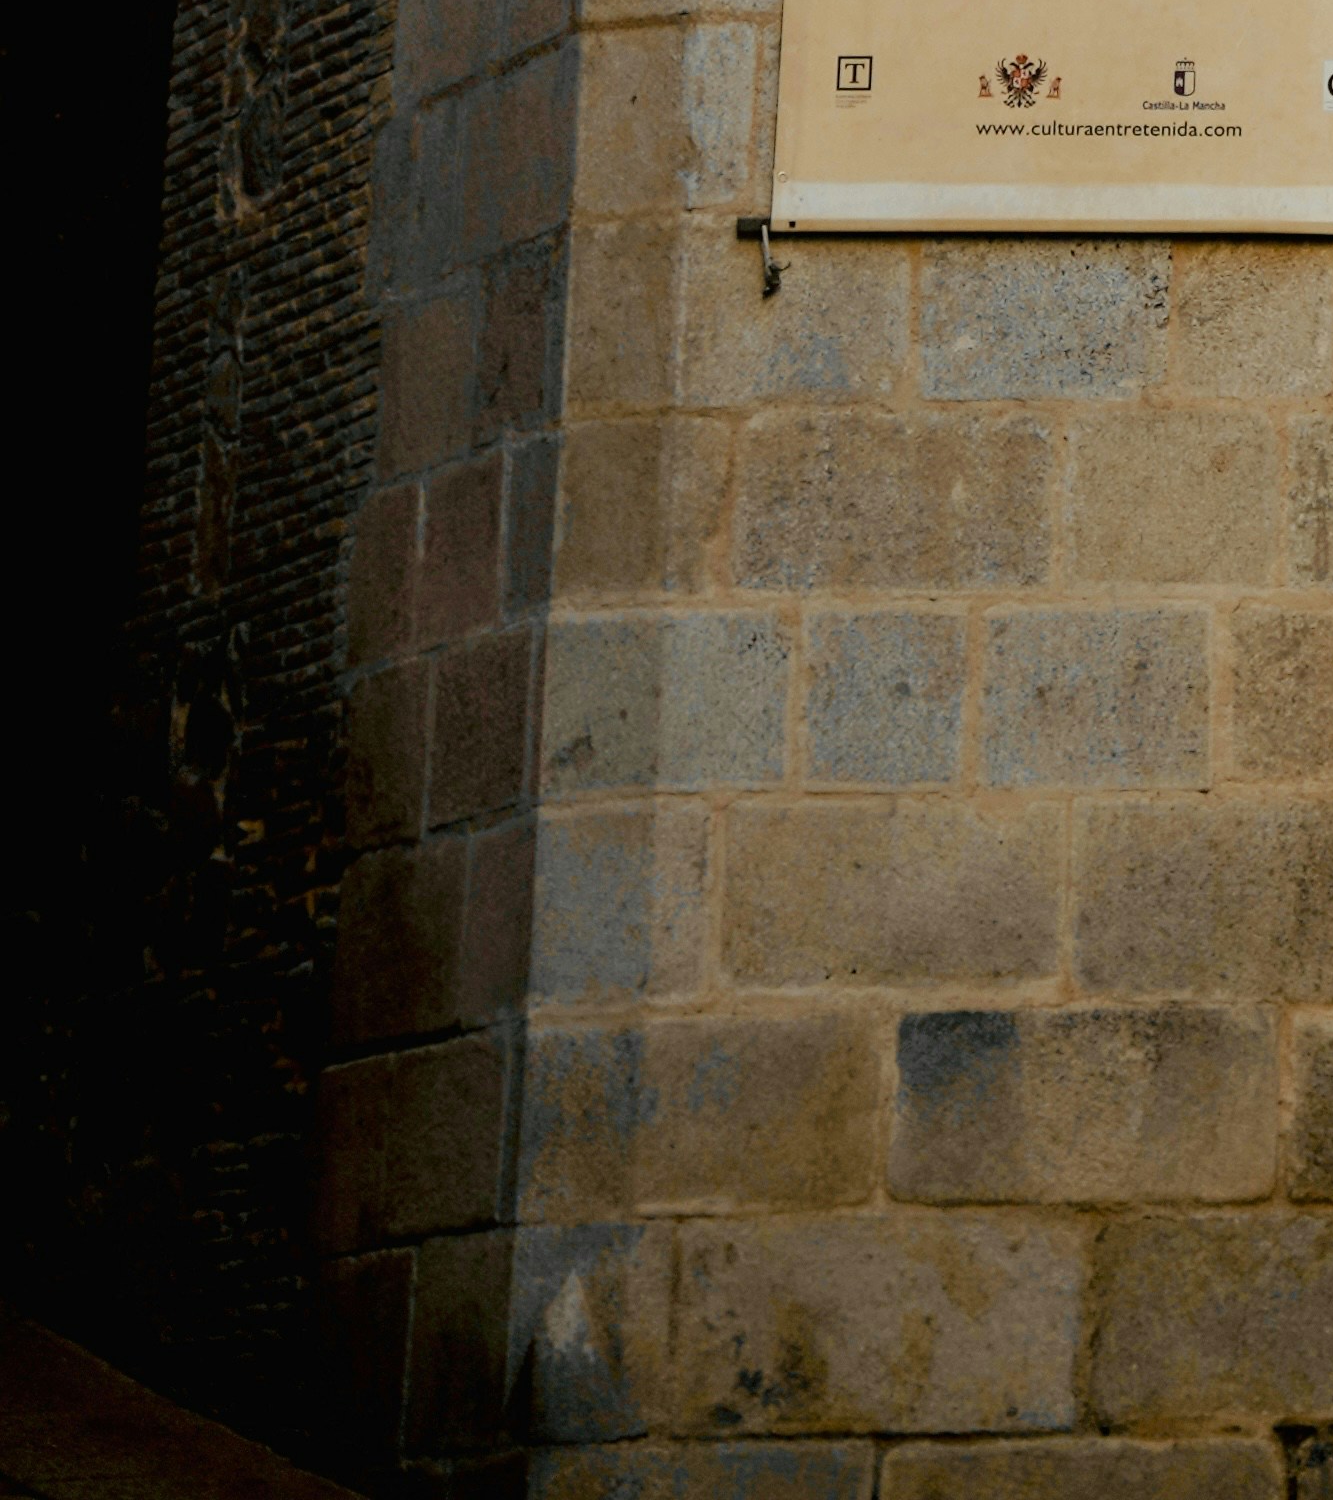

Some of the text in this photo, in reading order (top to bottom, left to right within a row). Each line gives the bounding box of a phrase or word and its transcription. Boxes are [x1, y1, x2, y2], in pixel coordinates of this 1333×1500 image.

[844, 62, 866, 85] T
[1142, 99, 1226, 111] Castilla-La Mancha
[975, 120, 1243, 138] www.culturaentretenida.com
